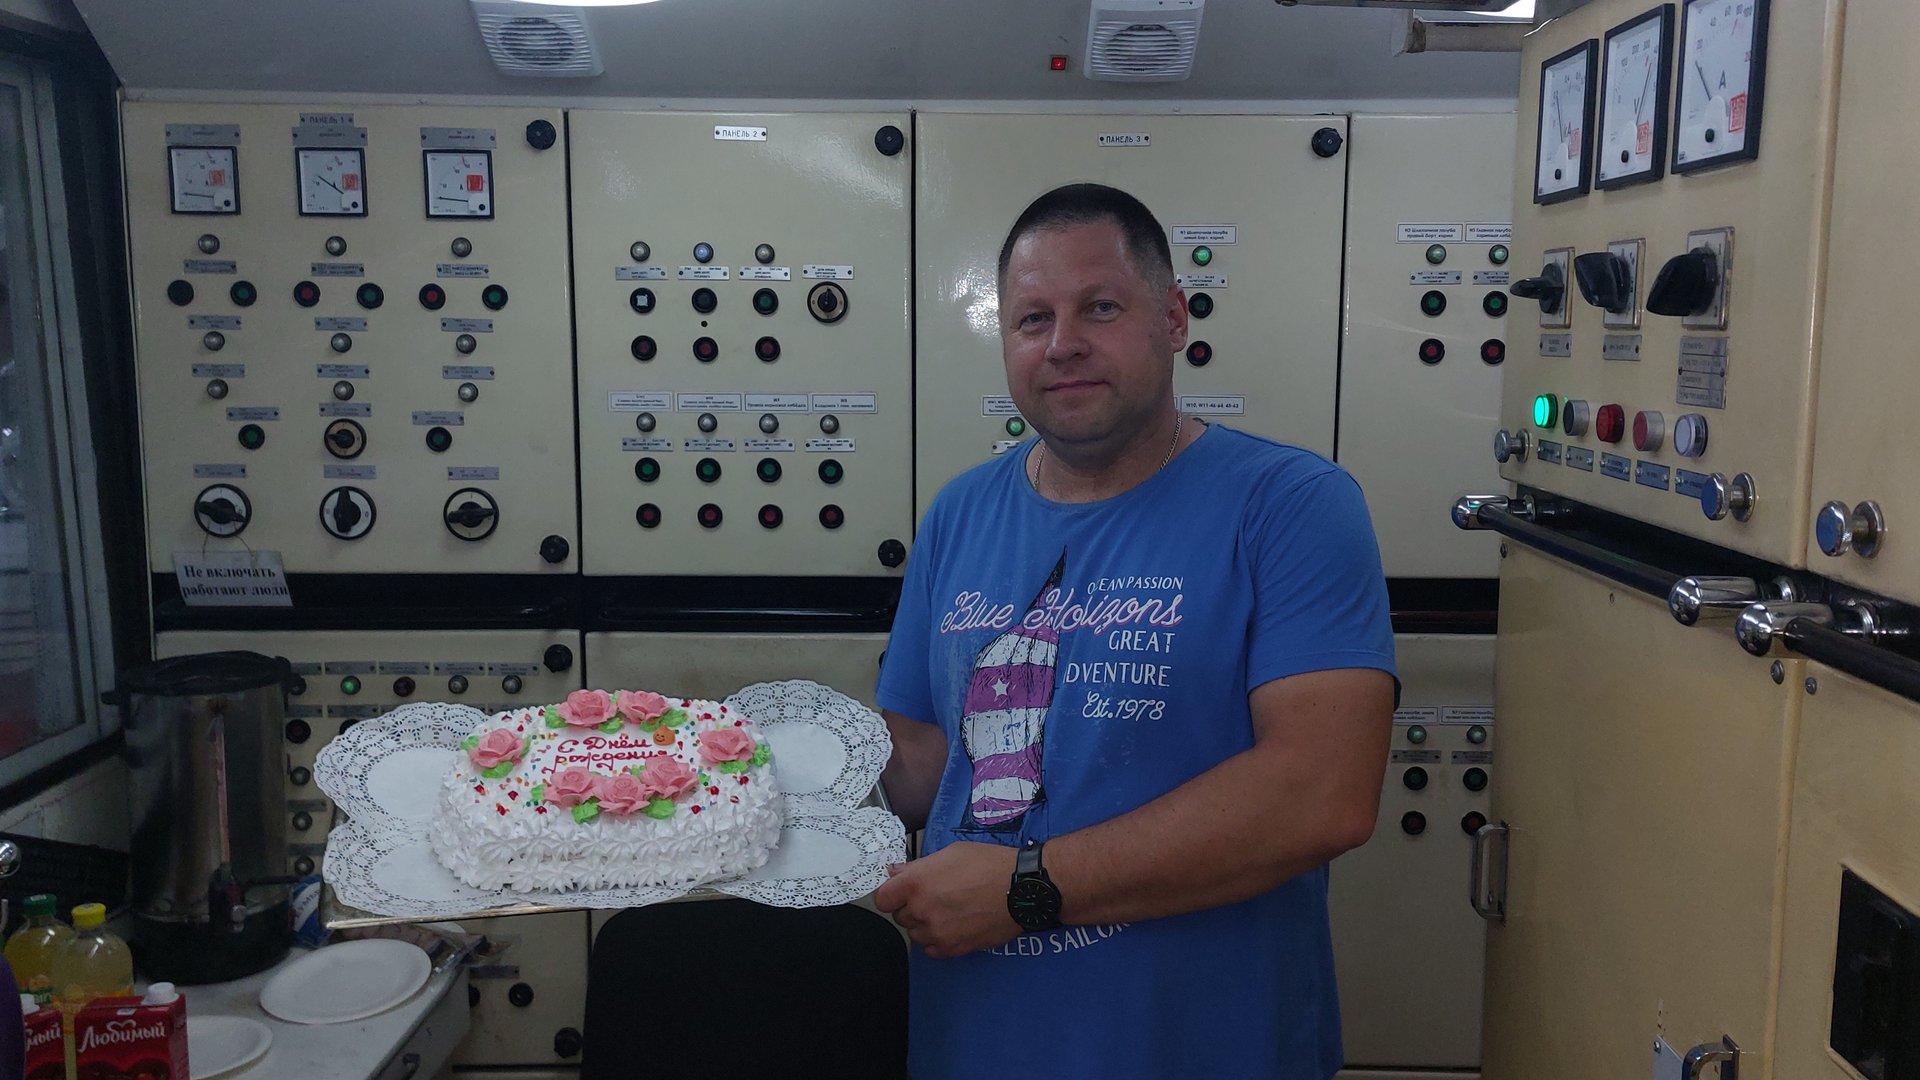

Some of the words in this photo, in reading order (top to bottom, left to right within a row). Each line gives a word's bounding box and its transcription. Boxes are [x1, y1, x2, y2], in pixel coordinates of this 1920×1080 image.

[1718, 69, 1727, 90] A
[1633, 96, 1640, 115] V
[722, 129, 750, 138] ПАНЕЛЬ
[753, 130, 758, 138] 2
[1106, 135, 1134, 143] ПАНЕЛЬ
[1136, 135, 1141, 143] 3
[184, 565, 203, 578] Не
[206, 566, 276, 578] включать
[181, 584, 248, 598] работают
[251, 585, 289, 597] люди
[1126, 576, 1184, 591] PASSION
[940, 590, 1016, 634] Blue
[1108, 630, 1176, 654] GREAT
[557, 739, 579, 754] С
[583, 733, 653, 750] Днём
[77, 1019, 166, 1053] Любимый
